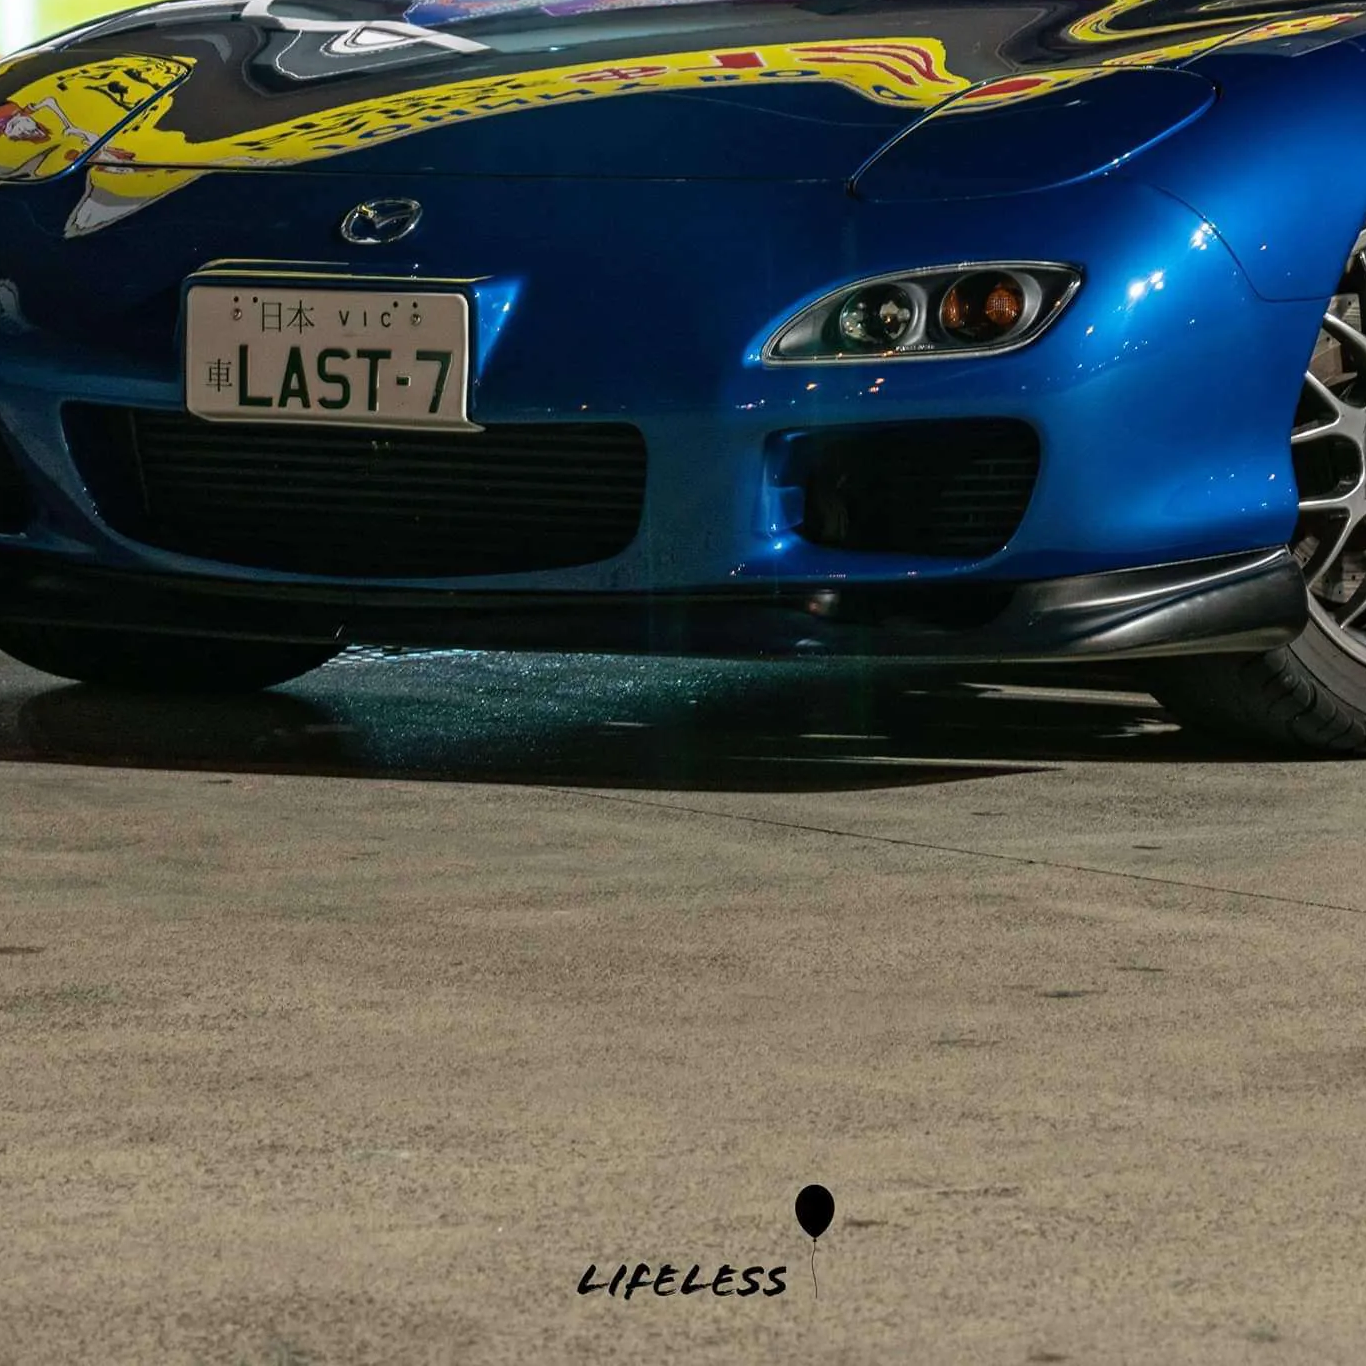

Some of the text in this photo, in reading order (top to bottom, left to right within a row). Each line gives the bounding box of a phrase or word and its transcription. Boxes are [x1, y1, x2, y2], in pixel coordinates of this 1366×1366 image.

[260, 299, 315, 334] 日本
[339, 309, 392, 328] VIC
[205, 358, 233, 393] 車
[238, 343, 454, 414] LAST-7
